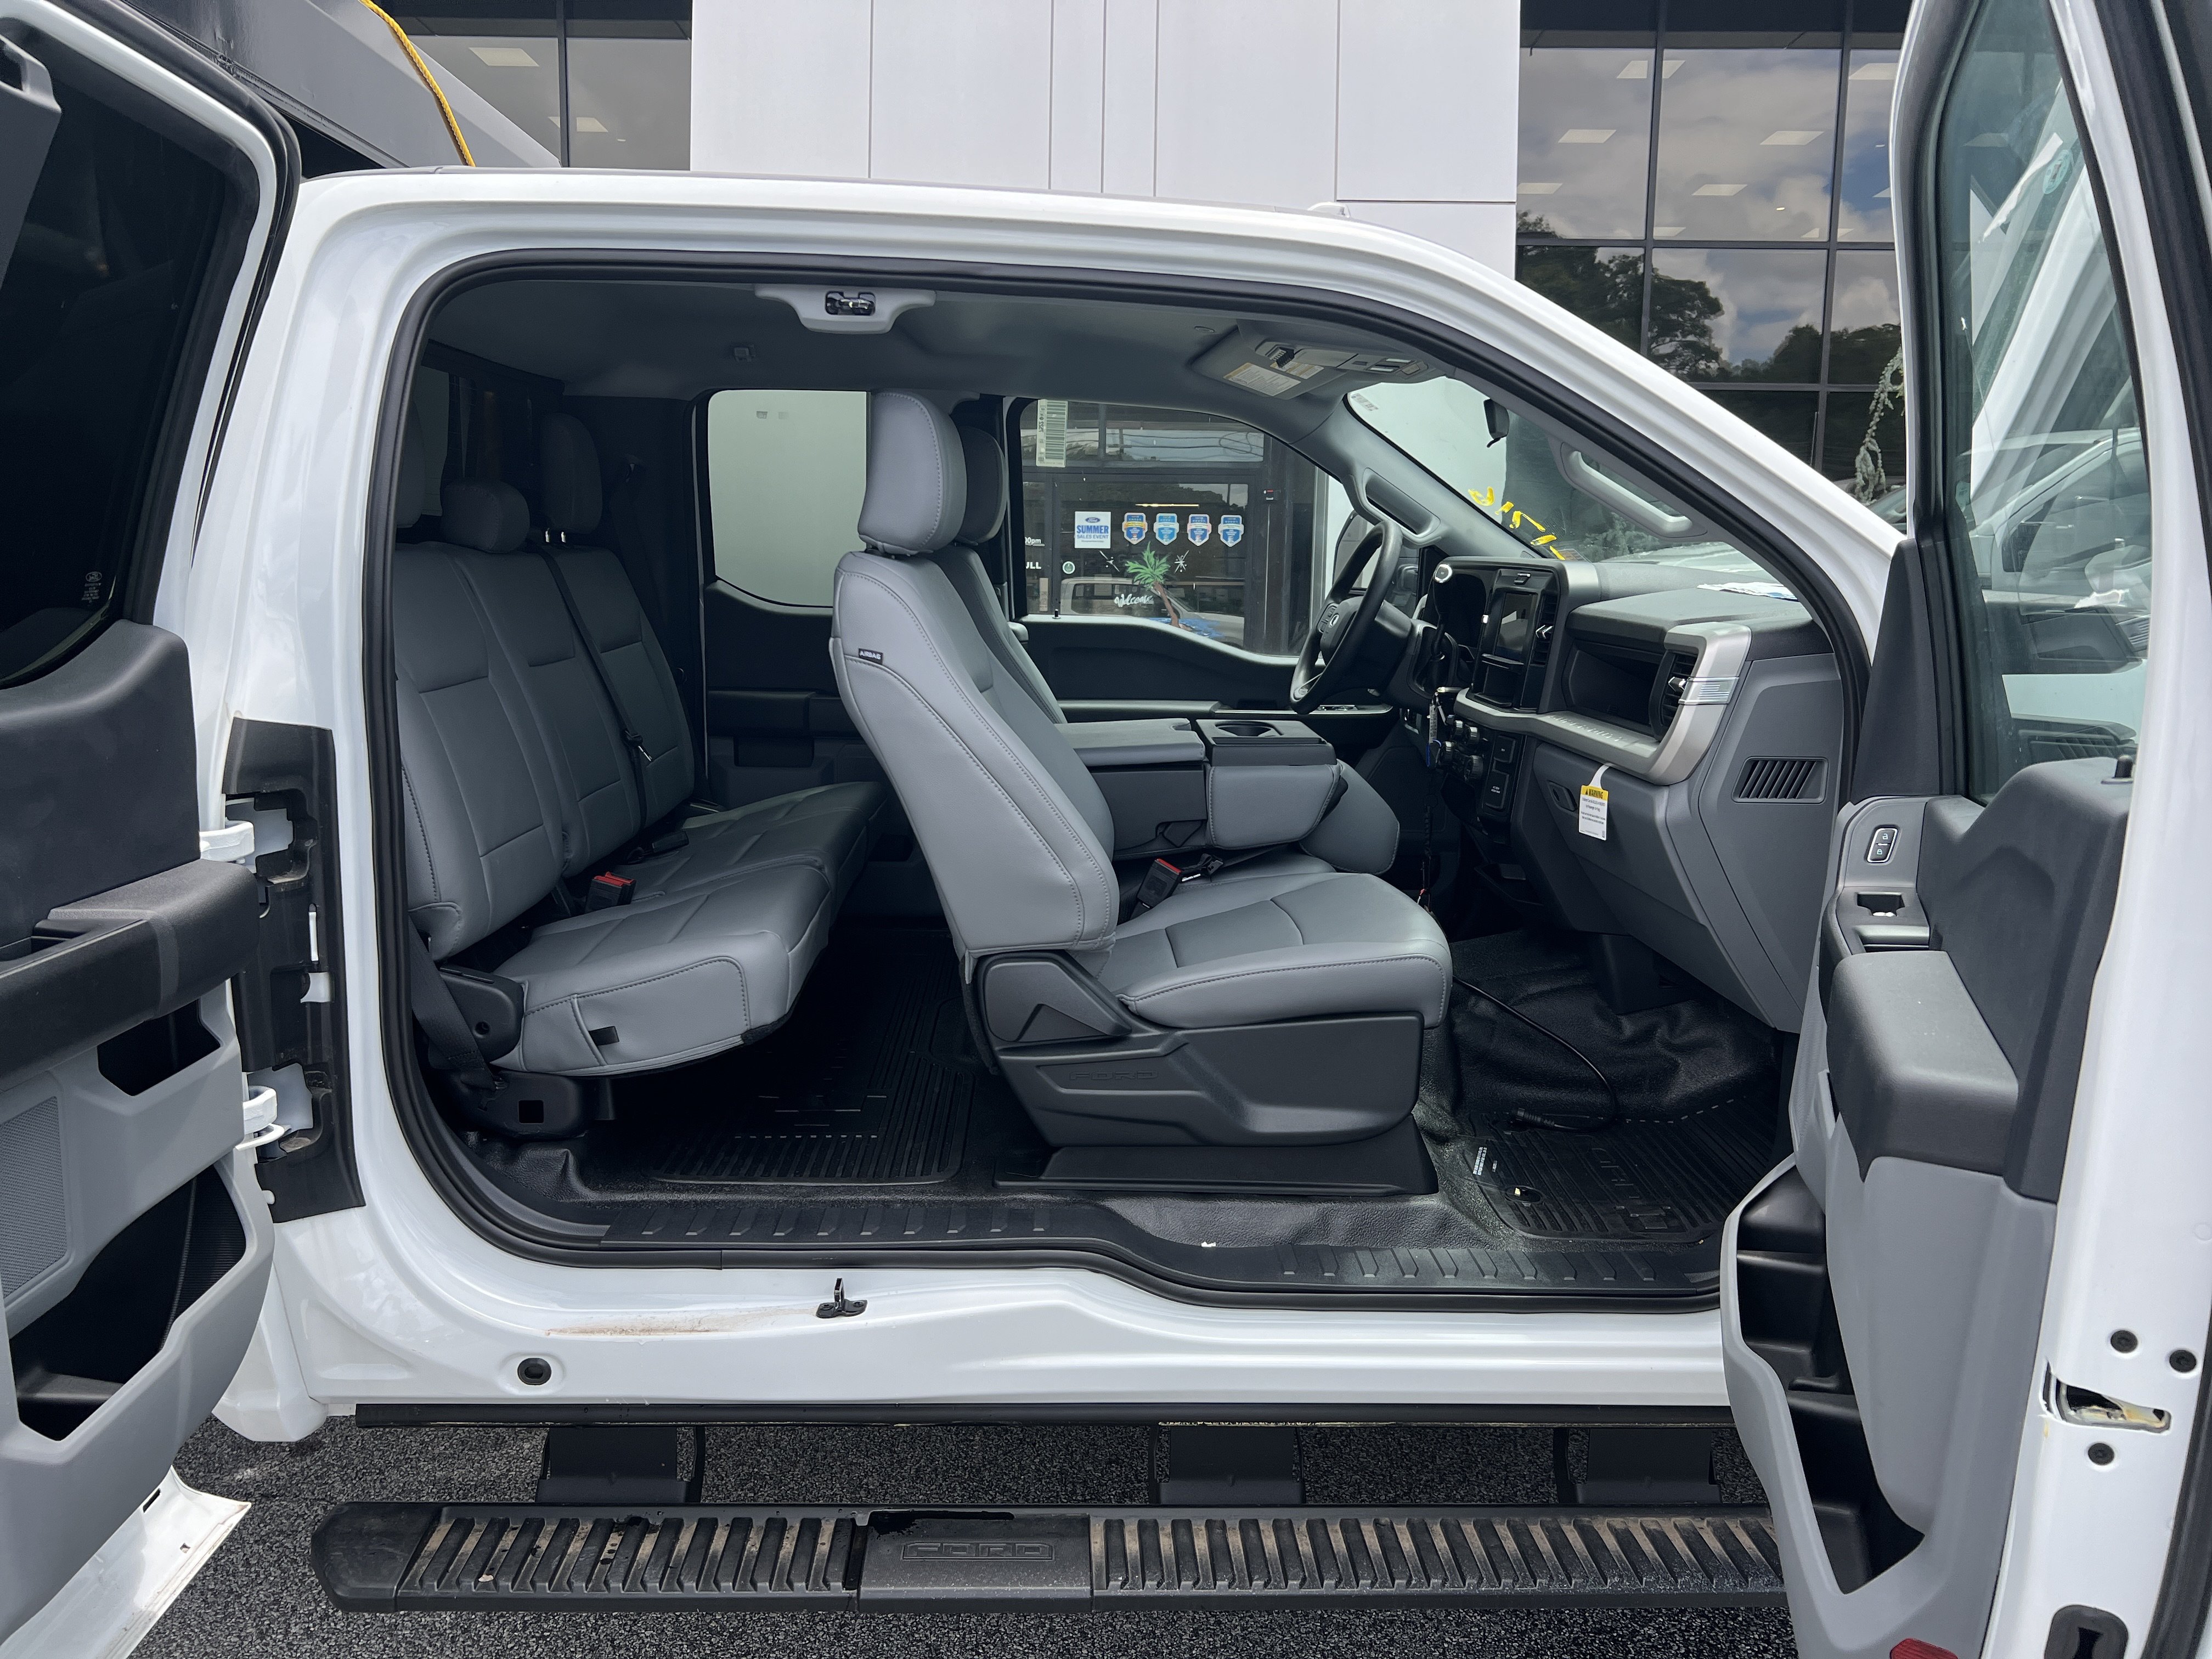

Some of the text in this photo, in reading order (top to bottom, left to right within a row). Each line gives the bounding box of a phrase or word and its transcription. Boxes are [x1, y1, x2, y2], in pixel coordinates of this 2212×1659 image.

[1076, 525, 1109, 533] SUMMER
[859, 650, 881, 660] AIRBAG
[1070, 1070, 1159, 1080] FORD
[904, 1542, 1051, 1558] FORD
